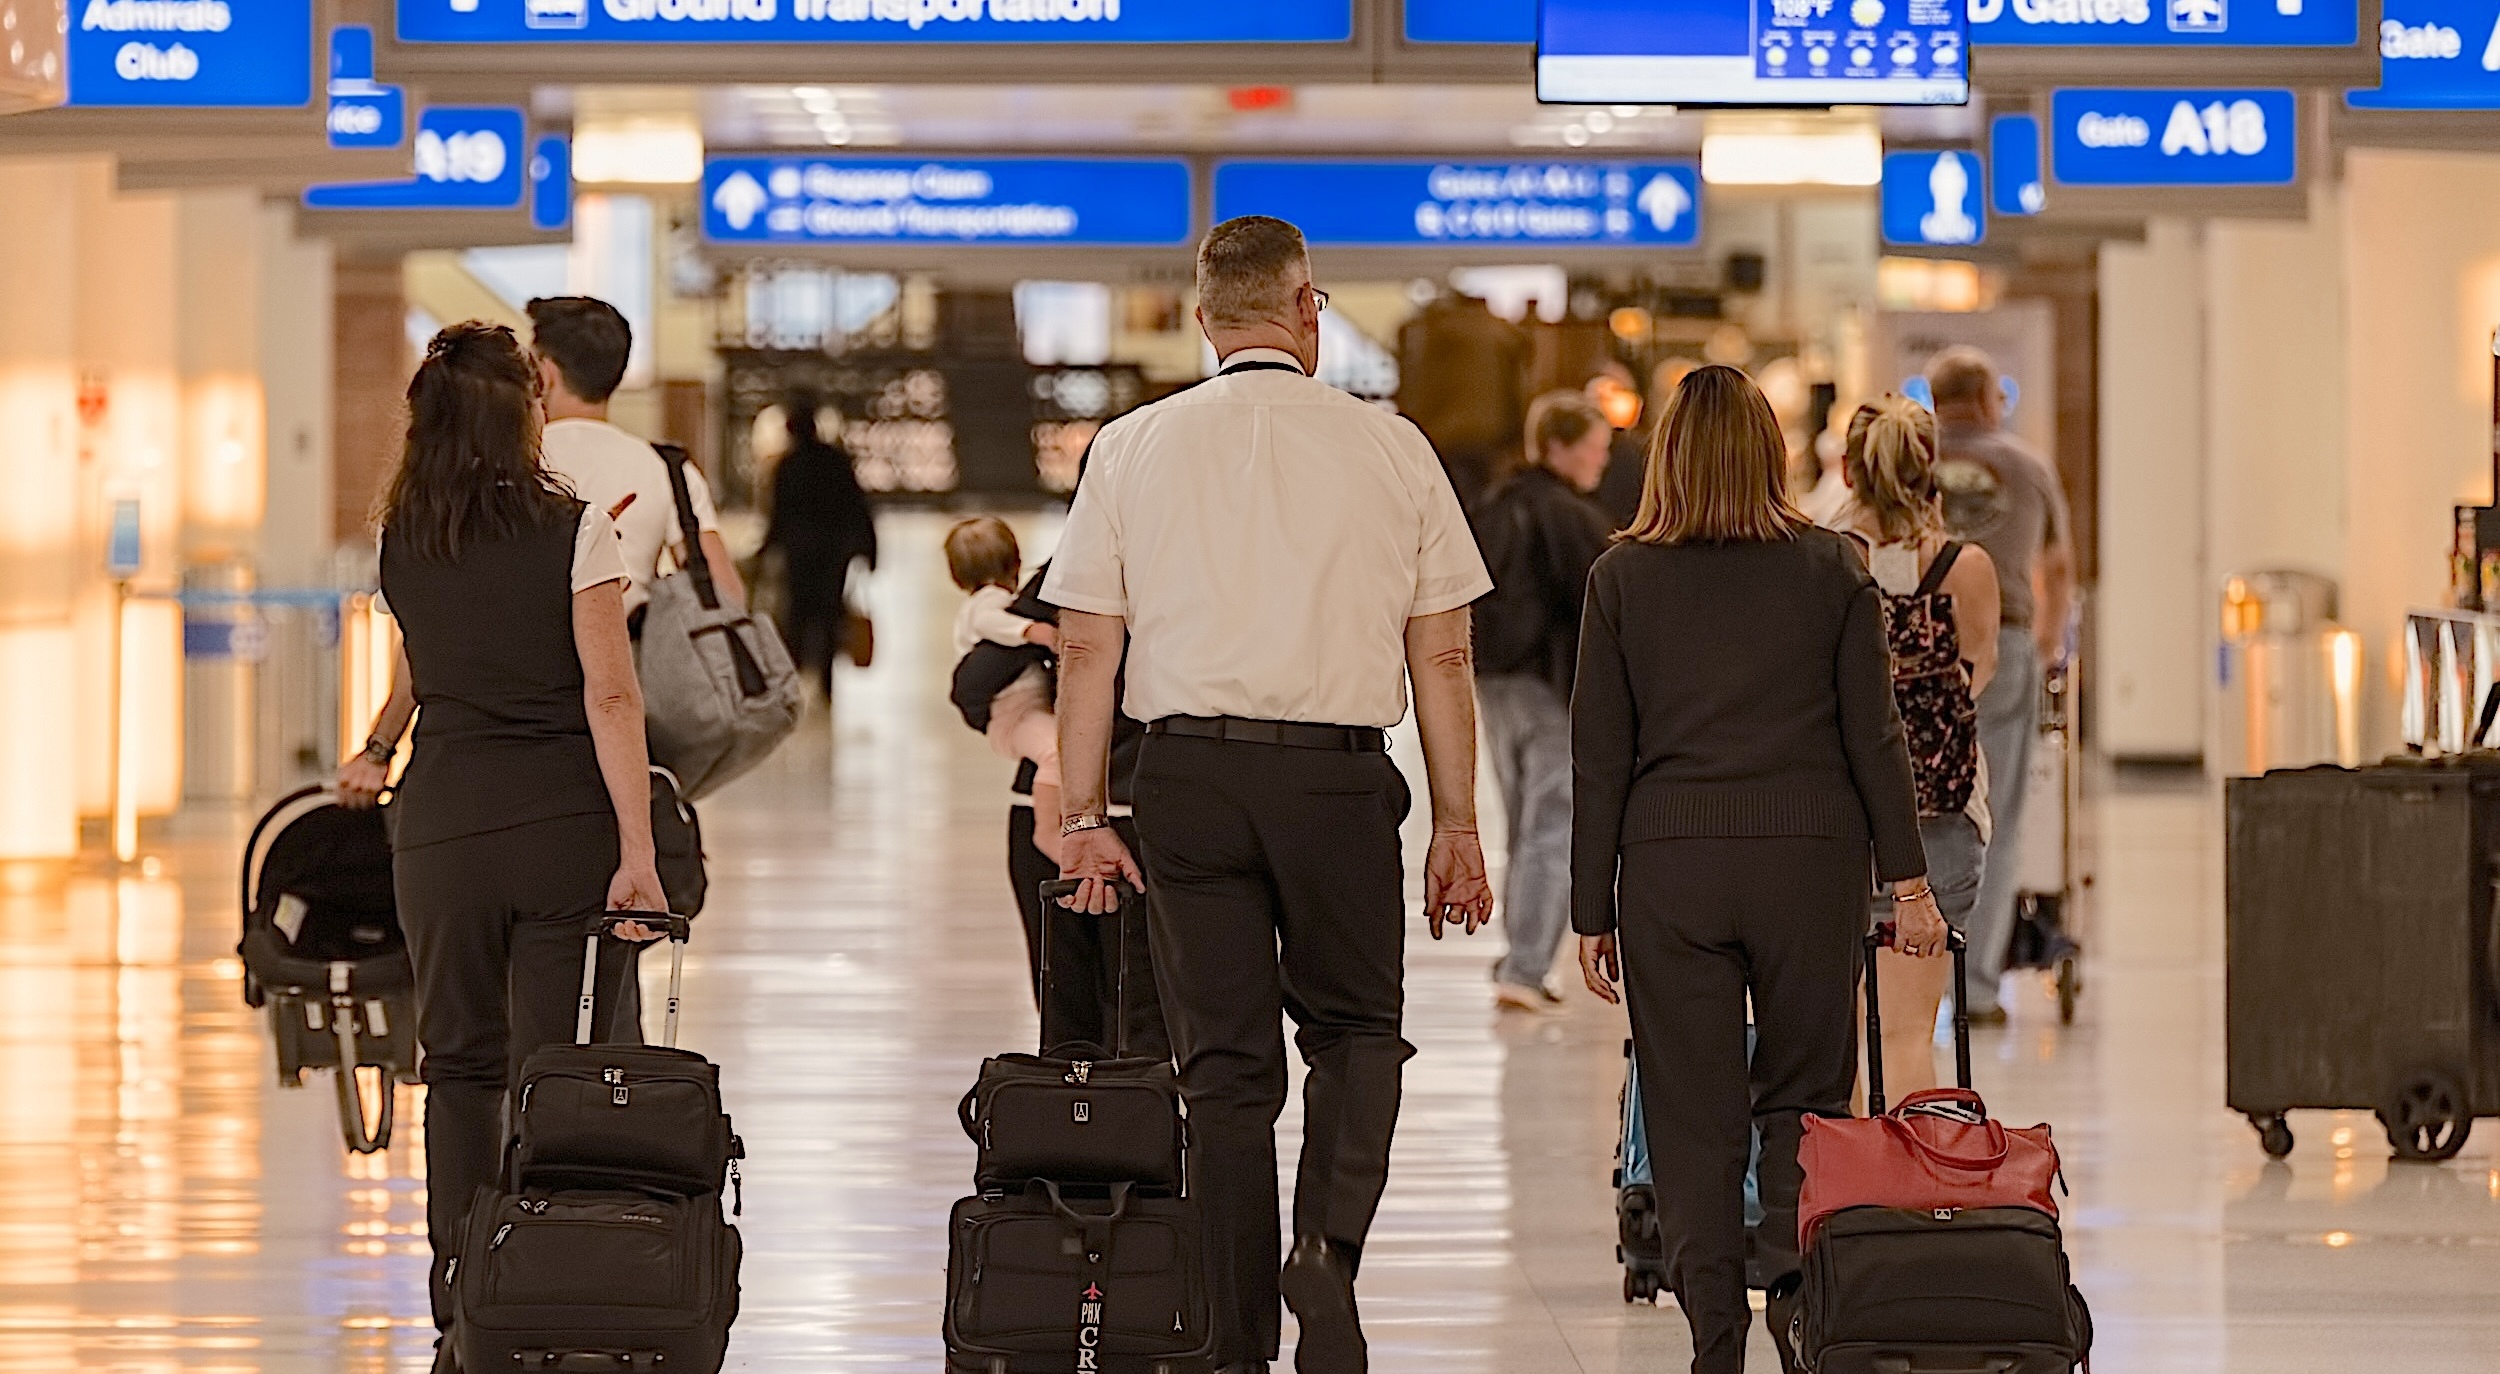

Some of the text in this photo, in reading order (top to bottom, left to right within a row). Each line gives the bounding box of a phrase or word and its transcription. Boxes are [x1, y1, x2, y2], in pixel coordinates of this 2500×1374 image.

[82, 0, 231, 31] Admirals
[2012, 0, 2150, 24] Gates
[2380, 19, 2461, 58] Gate
[115, 42, 199, 80] Club
[2077, 100, 2267, 155] Gate A18
[1081, 1303, 1102, 1325] PHX
[1077, 1327, 1099, 1374] CR
